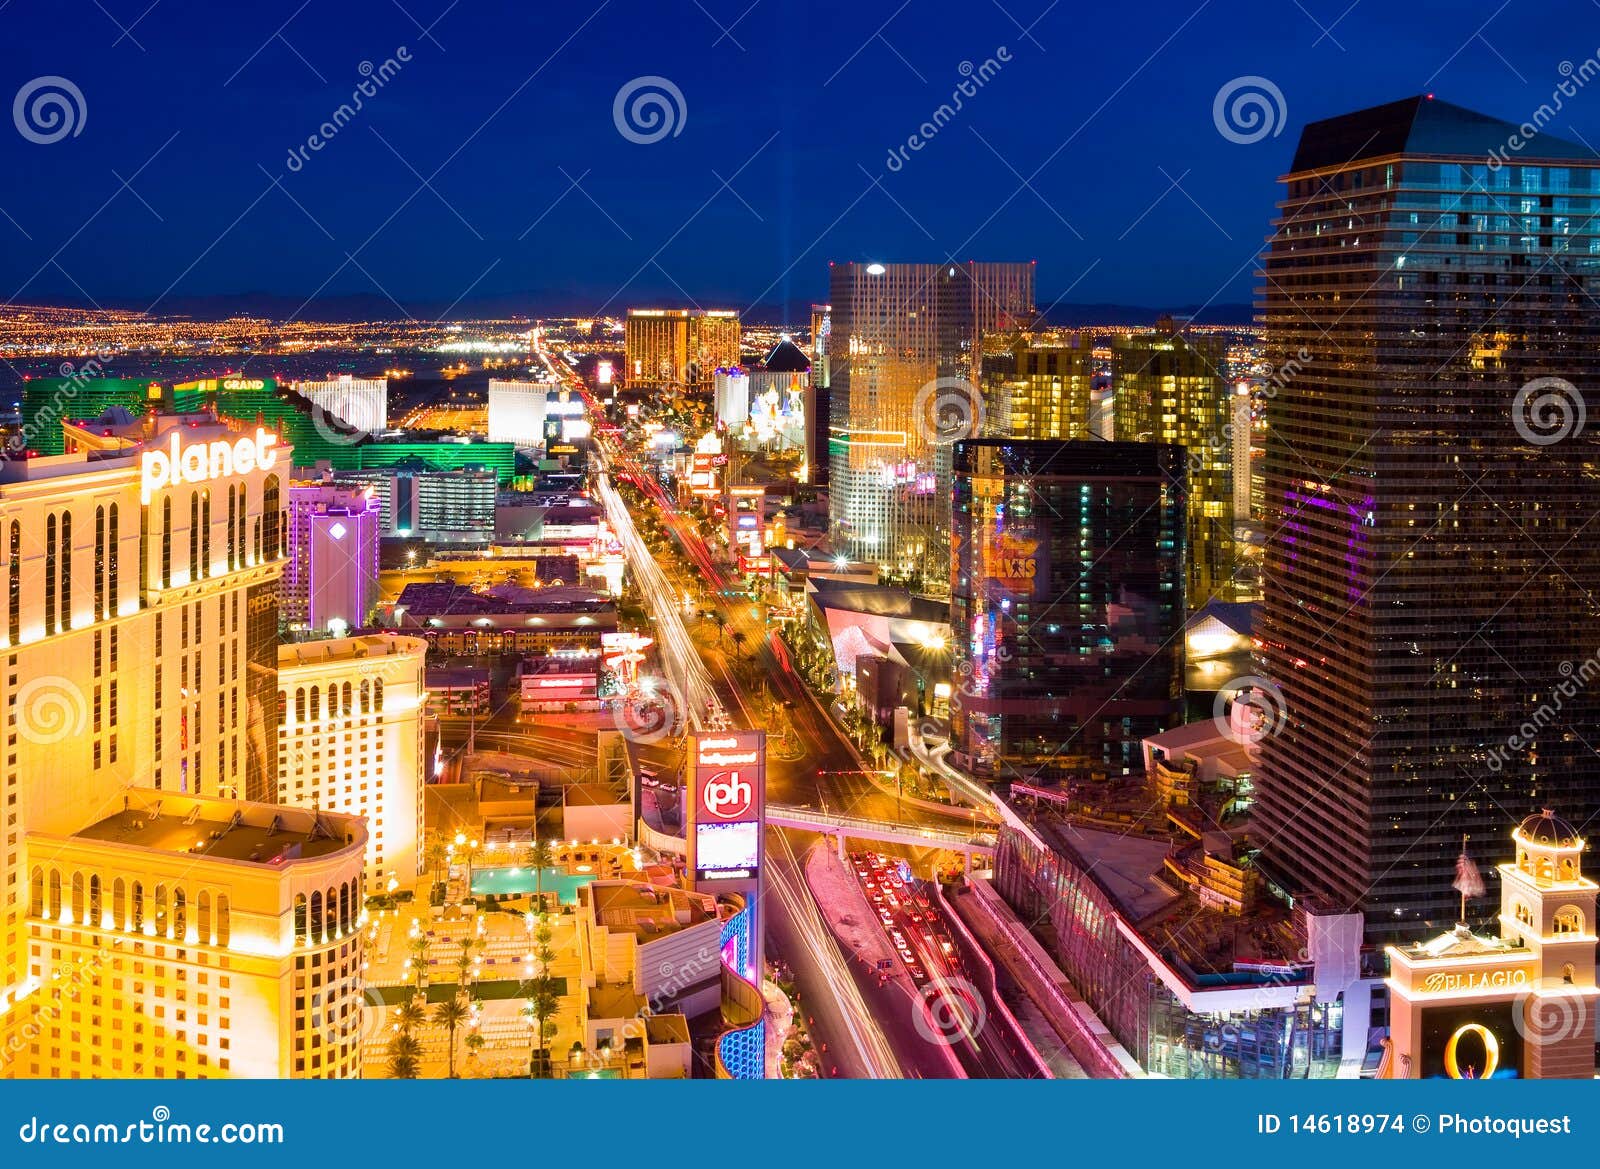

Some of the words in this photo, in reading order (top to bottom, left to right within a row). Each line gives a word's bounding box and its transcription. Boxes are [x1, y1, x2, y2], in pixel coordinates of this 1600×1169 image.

[223, 379, 265, 390] GRAND
[141, 427, 277, 506] planet
[984, 558, 1037, 578] ELVIS
[1419, 969, 1528, 993] BELLAGIO
